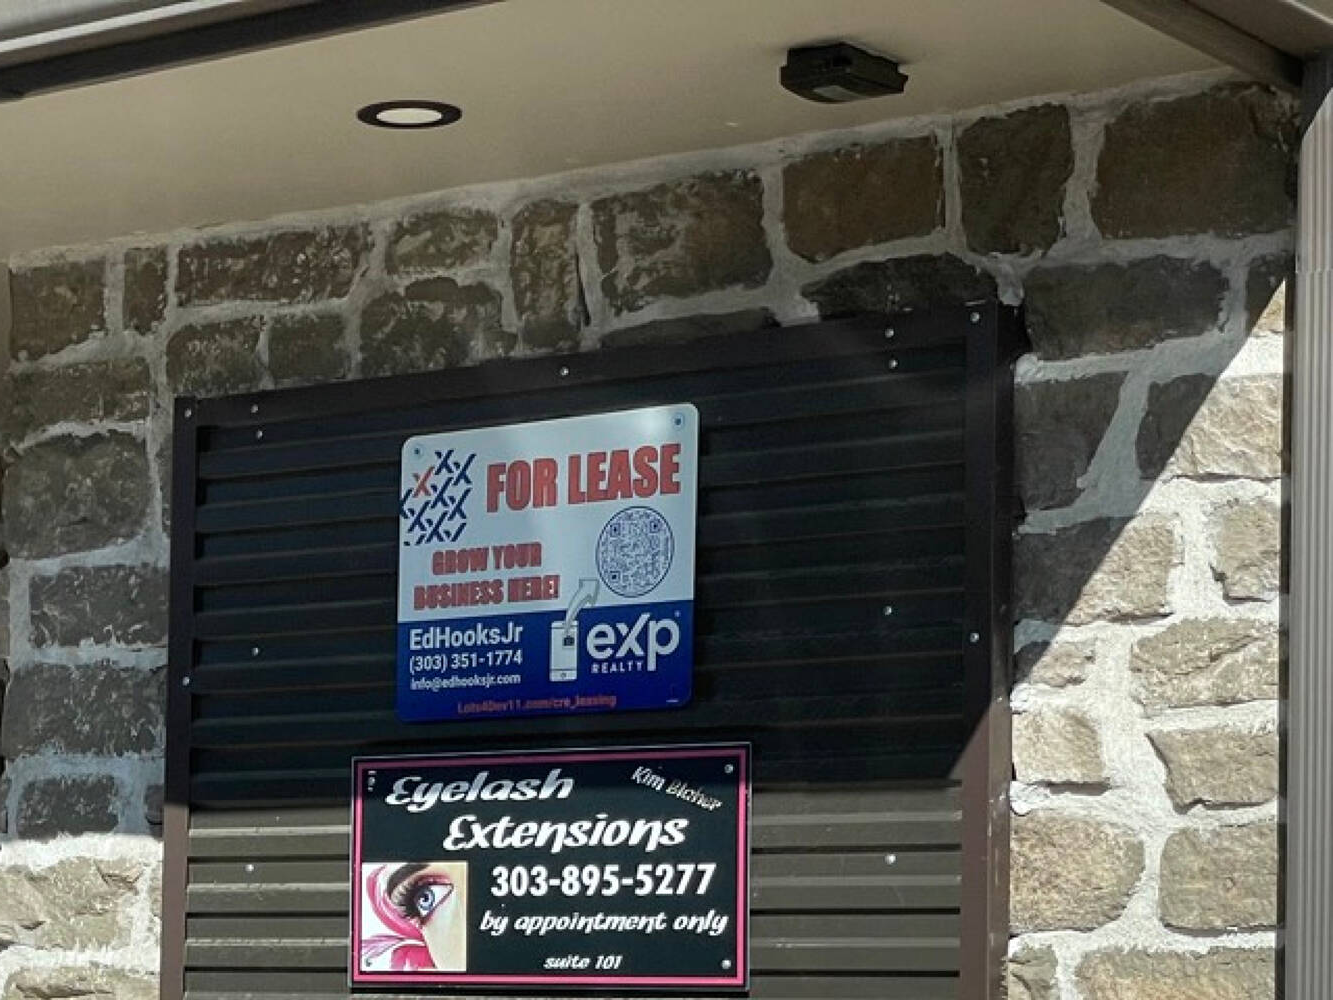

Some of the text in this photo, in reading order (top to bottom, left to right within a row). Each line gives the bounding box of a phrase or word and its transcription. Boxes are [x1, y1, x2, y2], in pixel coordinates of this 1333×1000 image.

[486, 443, 681, 513] FOR LEASE
[432, 541, 542, 576] GROW YOUR
[413, 574, 560, 611] BUSINESS HERE!
[410, 621, 524, 651] EdHooksJr
[409, 649, 523, 676] (303) 351-1774
[591, 660, 644, 674] REALTY
[410, 673, 522, 692] info@edhooksjr.com
[385, 769, 574, 812] Eyelash
[631, 766, 665, 791] Kim
[443, 813, 689, 852] Extensions
[490, 863, 717, 897] 303-895-5277
[479, 909, 729, 936] by appointment only
[543, 954, 623, 970] suite 101
